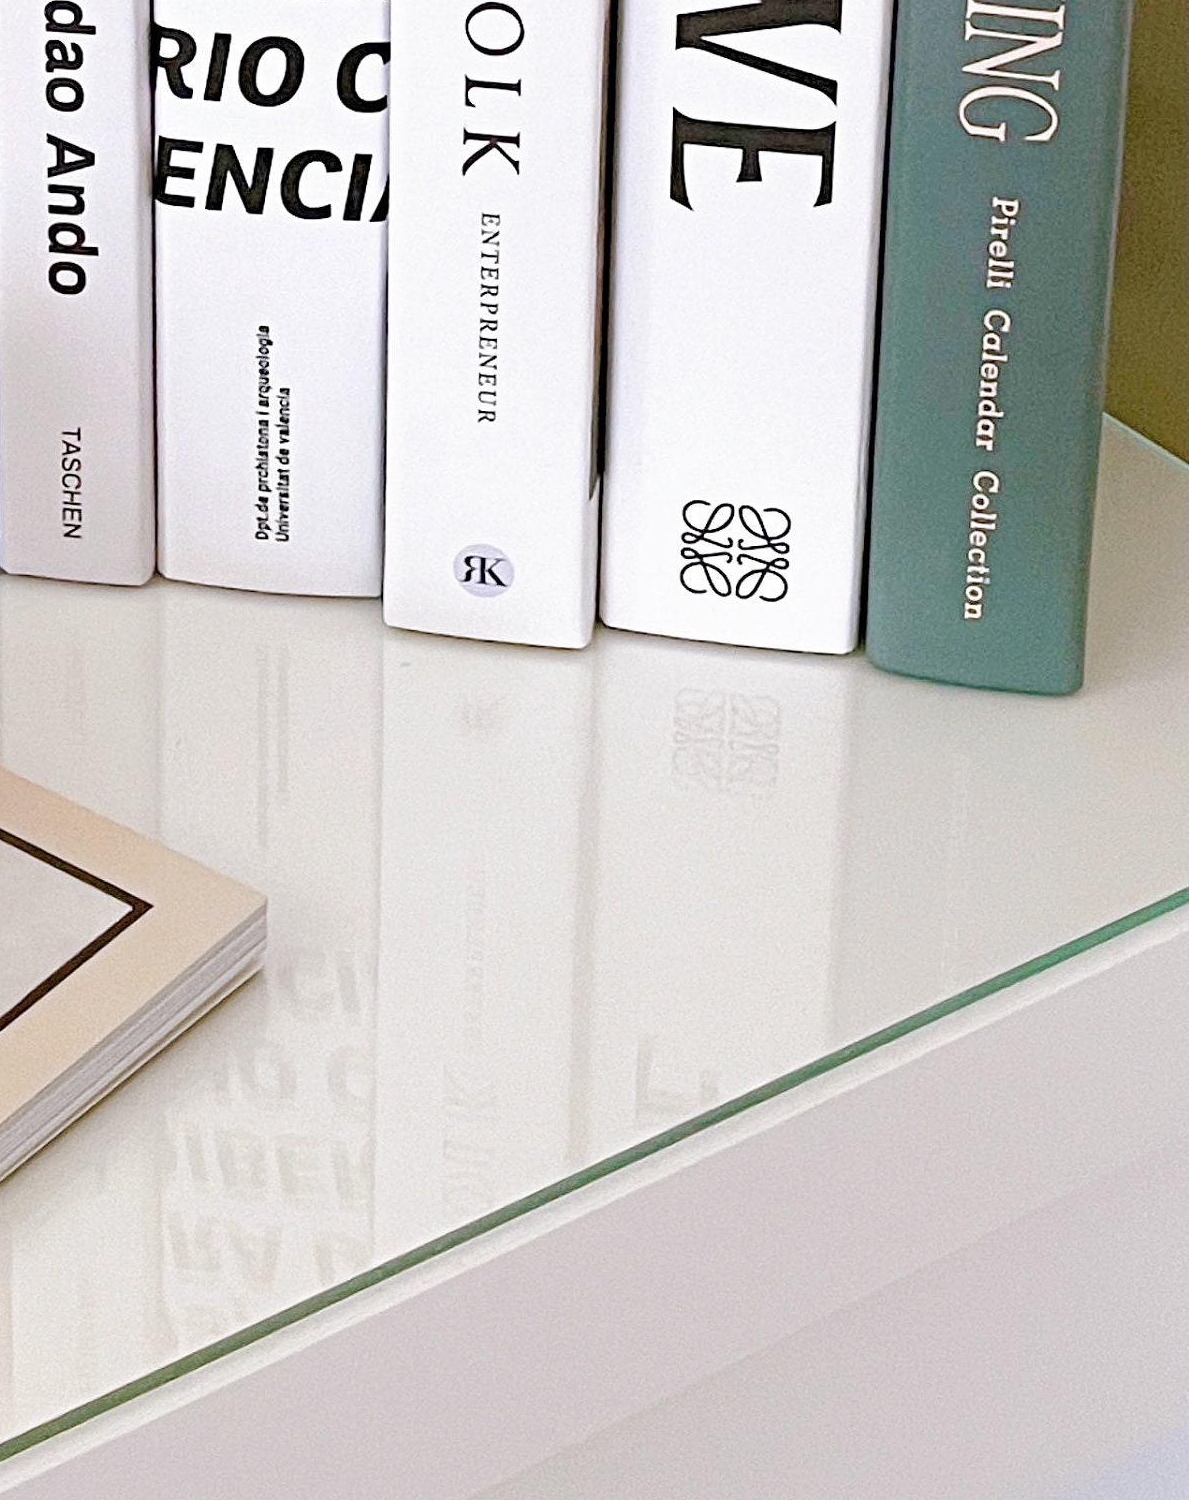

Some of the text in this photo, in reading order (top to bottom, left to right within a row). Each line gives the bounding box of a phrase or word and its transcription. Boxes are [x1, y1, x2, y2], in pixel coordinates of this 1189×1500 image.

[46, 132, 99, 295] Ando
[477, 212, 501, 424] ENTERPRENEUR
[60, 426, 83, 540] TASCHEN
[276, 448, 290, 466] de
[963, 195, 1020, 620] Pirelli Calendar Collection
